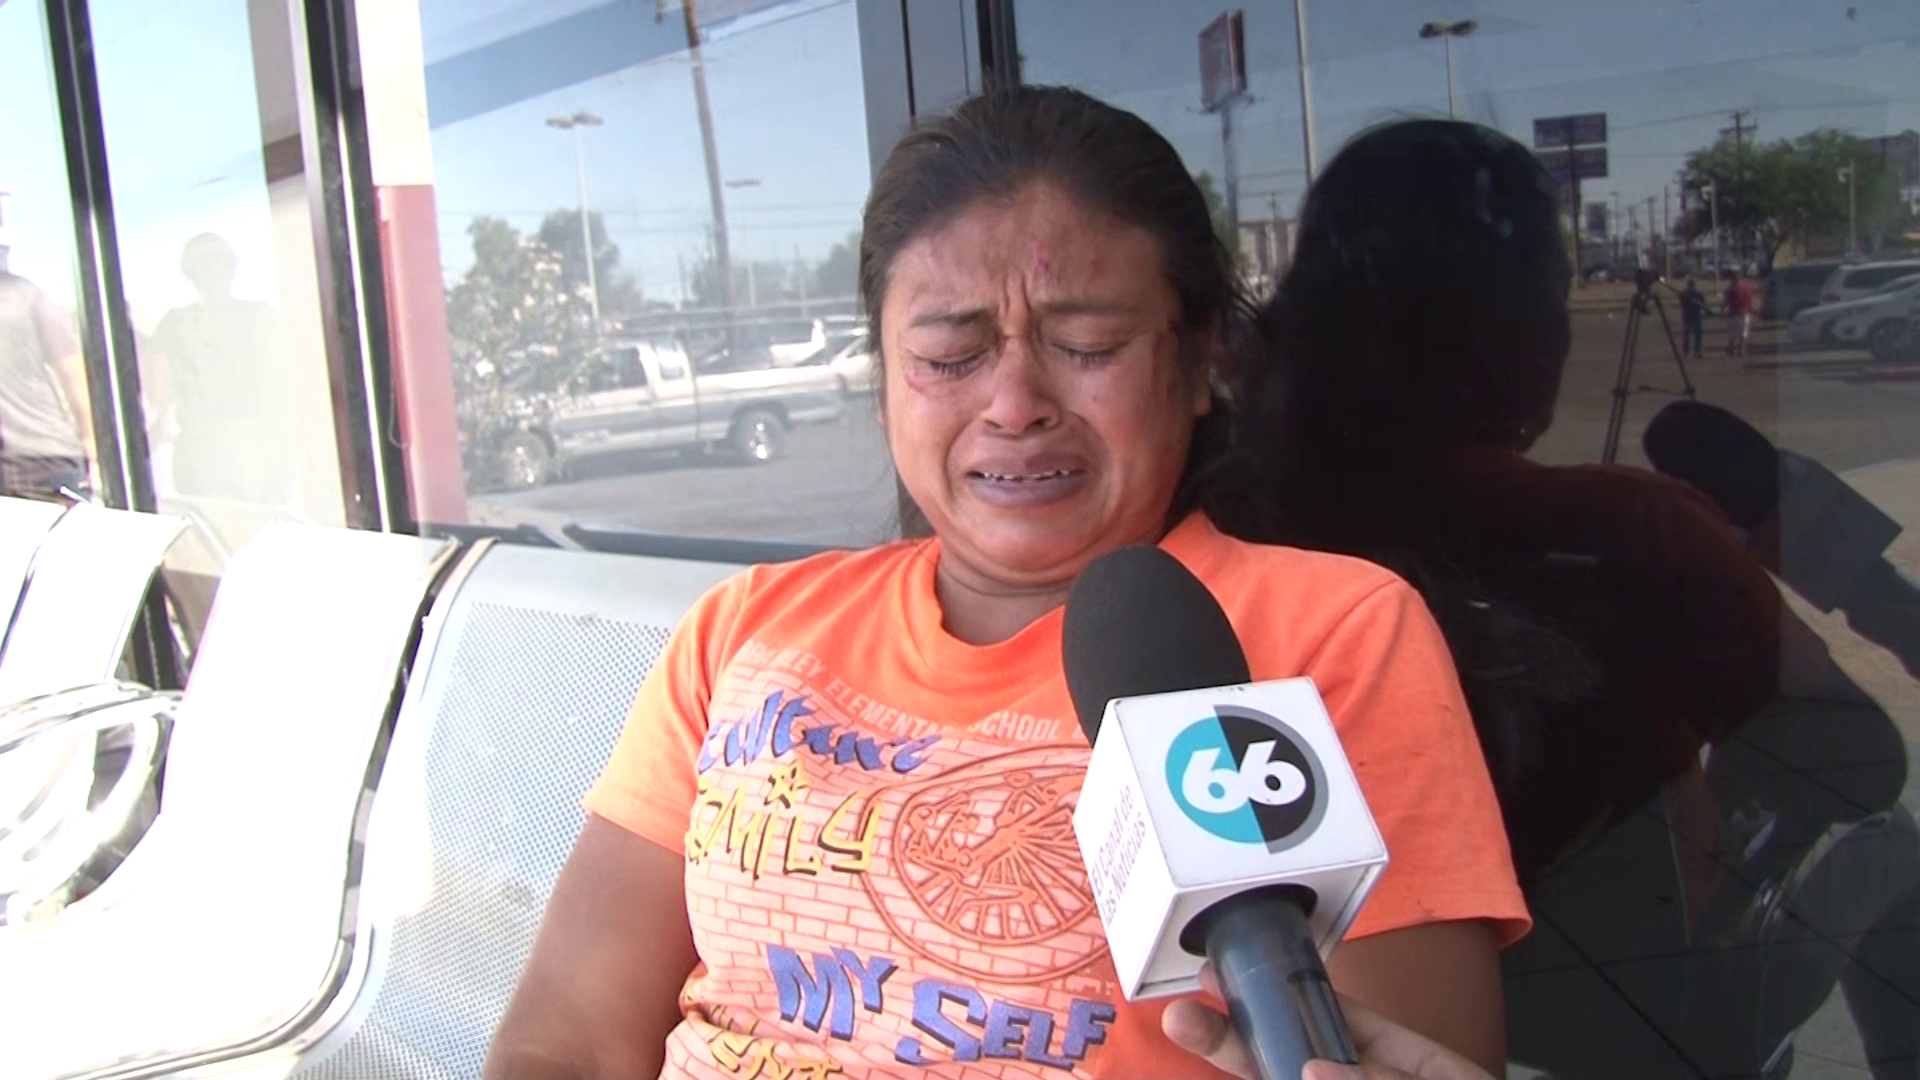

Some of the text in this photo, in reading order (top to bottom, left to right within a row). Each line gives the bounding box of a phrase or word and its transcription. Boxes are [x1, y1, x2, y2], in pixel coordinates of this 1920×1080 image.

[1181, 739, 1307, 814] 66
[1098, 805, 1124, 879] Canal
[1119, 784, 1134, 822] de
[1111, 811, 1147, 901] Noticias
